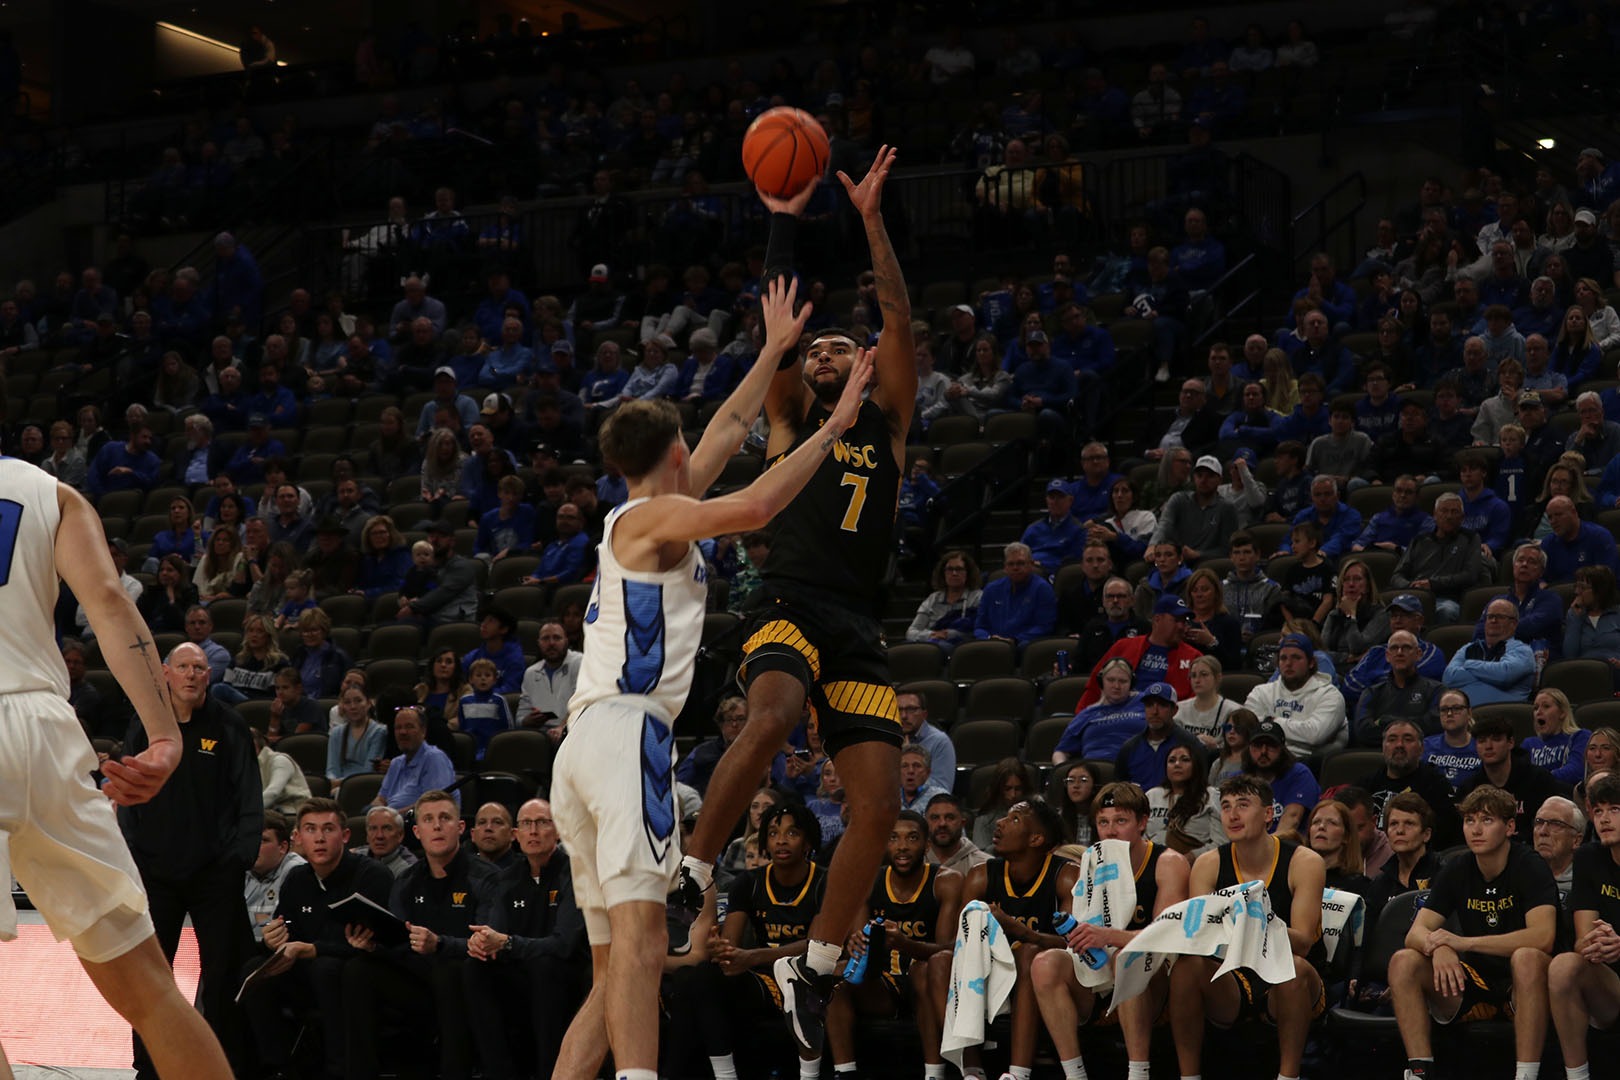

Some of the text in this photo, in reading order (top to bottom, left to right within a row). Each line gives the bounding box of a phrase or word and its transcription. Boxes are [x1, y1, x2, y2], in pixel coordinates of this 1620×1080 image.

[833, 439, 878, 469] WSC
[1507, 474, 1517, 502] 1
[840, 471, 870, 532] 7
[1179, 659, 1190, 669] N
[200, 737, 219, 751] W
[765, 922, 806, 940] WSC
[898, 920, 928, 938] SC
